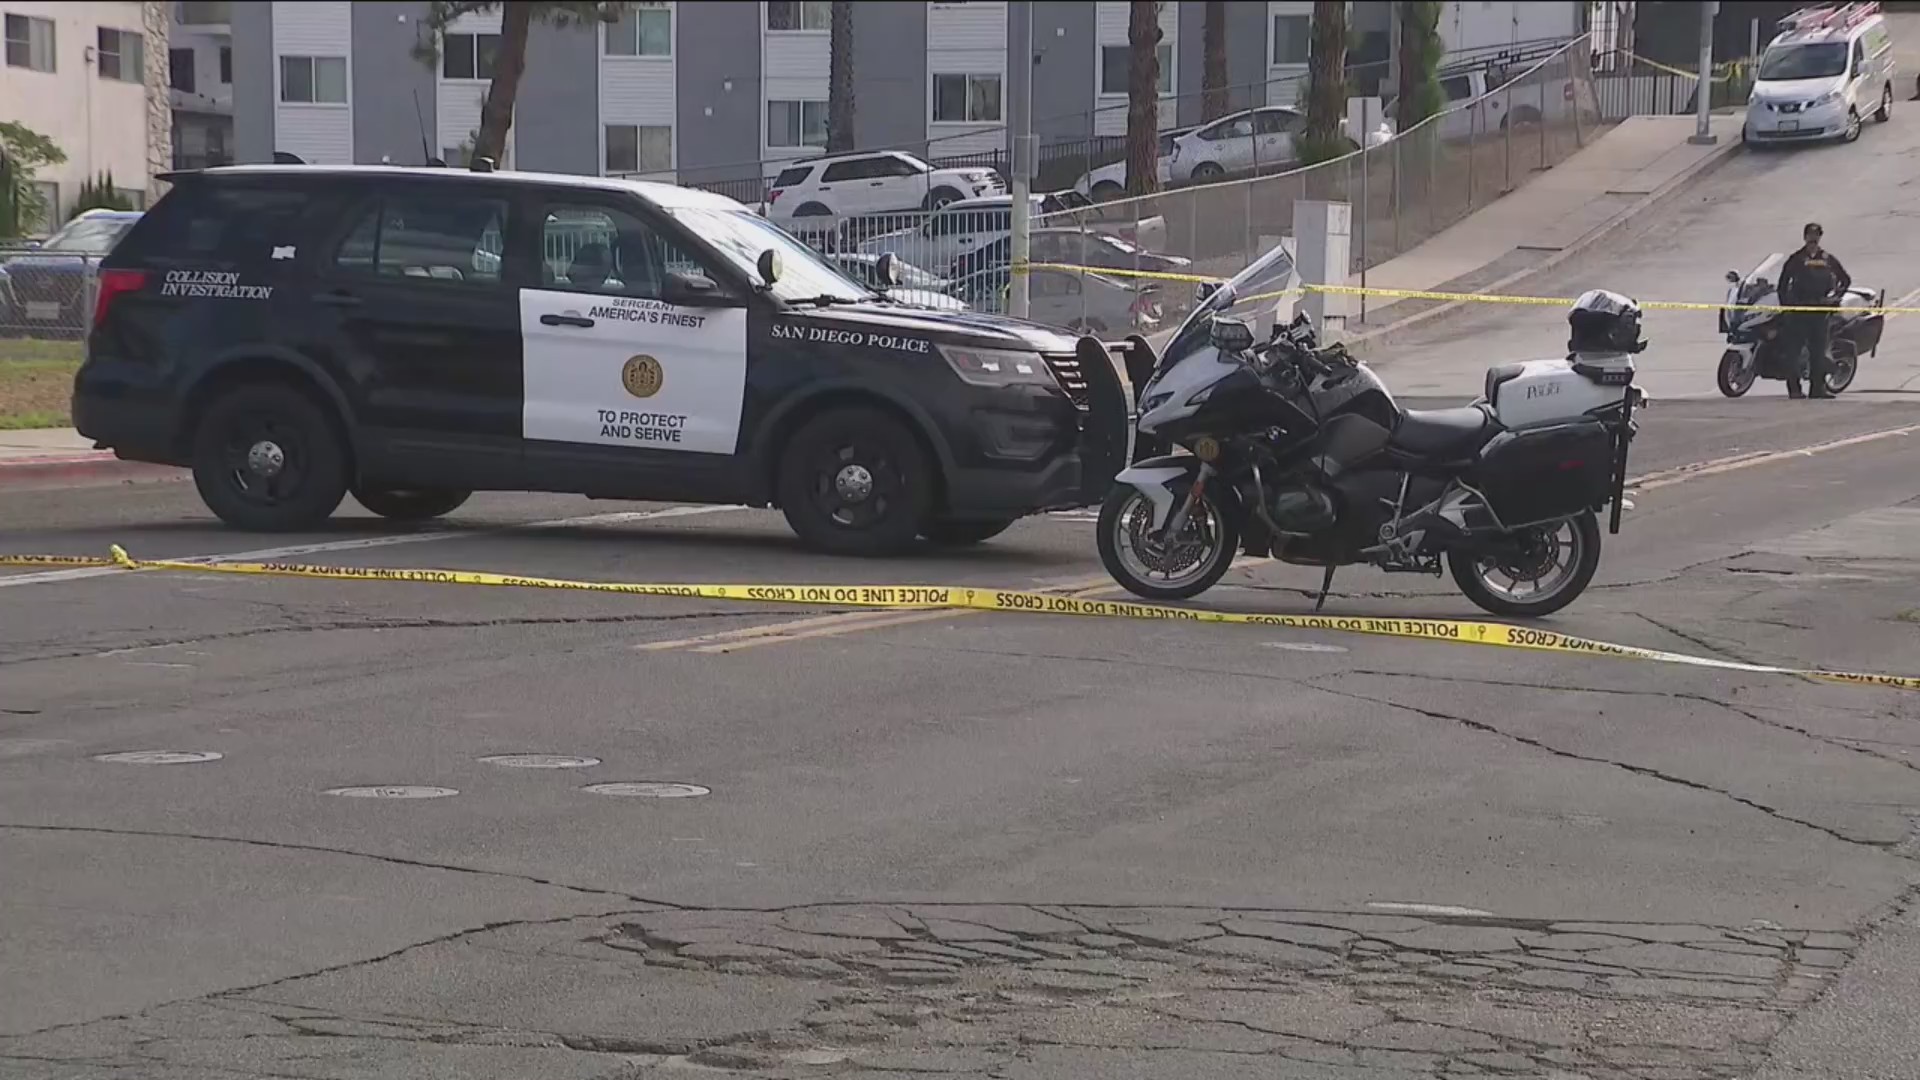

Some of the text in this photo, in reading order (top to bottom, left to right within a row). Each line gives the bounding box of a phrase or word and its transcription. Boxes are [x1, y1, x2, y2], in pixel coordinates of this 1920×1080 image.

[166, 270, 240, 284] COLLISION
[161, 283, 274, 299] INVESTIGATION
[612, 298, 676, 311] SERGEANT
[588, 306, 706, 328] AMERICA'S FINEST
[771, 324, 929, 353] SAN DIEGO POLICE
[597, 410, 687, 428] TO PROTECT
[600, 424, 681, 442] AND SERVE
[747, 587, 949, 603] POLICE LINE DO NOT CROSS
[996, 592, 1043, 609] CROSS
[1048, 598, 1079, 612] NOT
[1082, 601, 1106, 614] DO
[1110, 604, 1142, 617] LINE
[1337, 619, 1361, 630] DO
[1366, 620, 1400, 634] LINE
[1404, 621, 1459, 637] POLICE
[1507, 628, 1558, 647] CROSS
